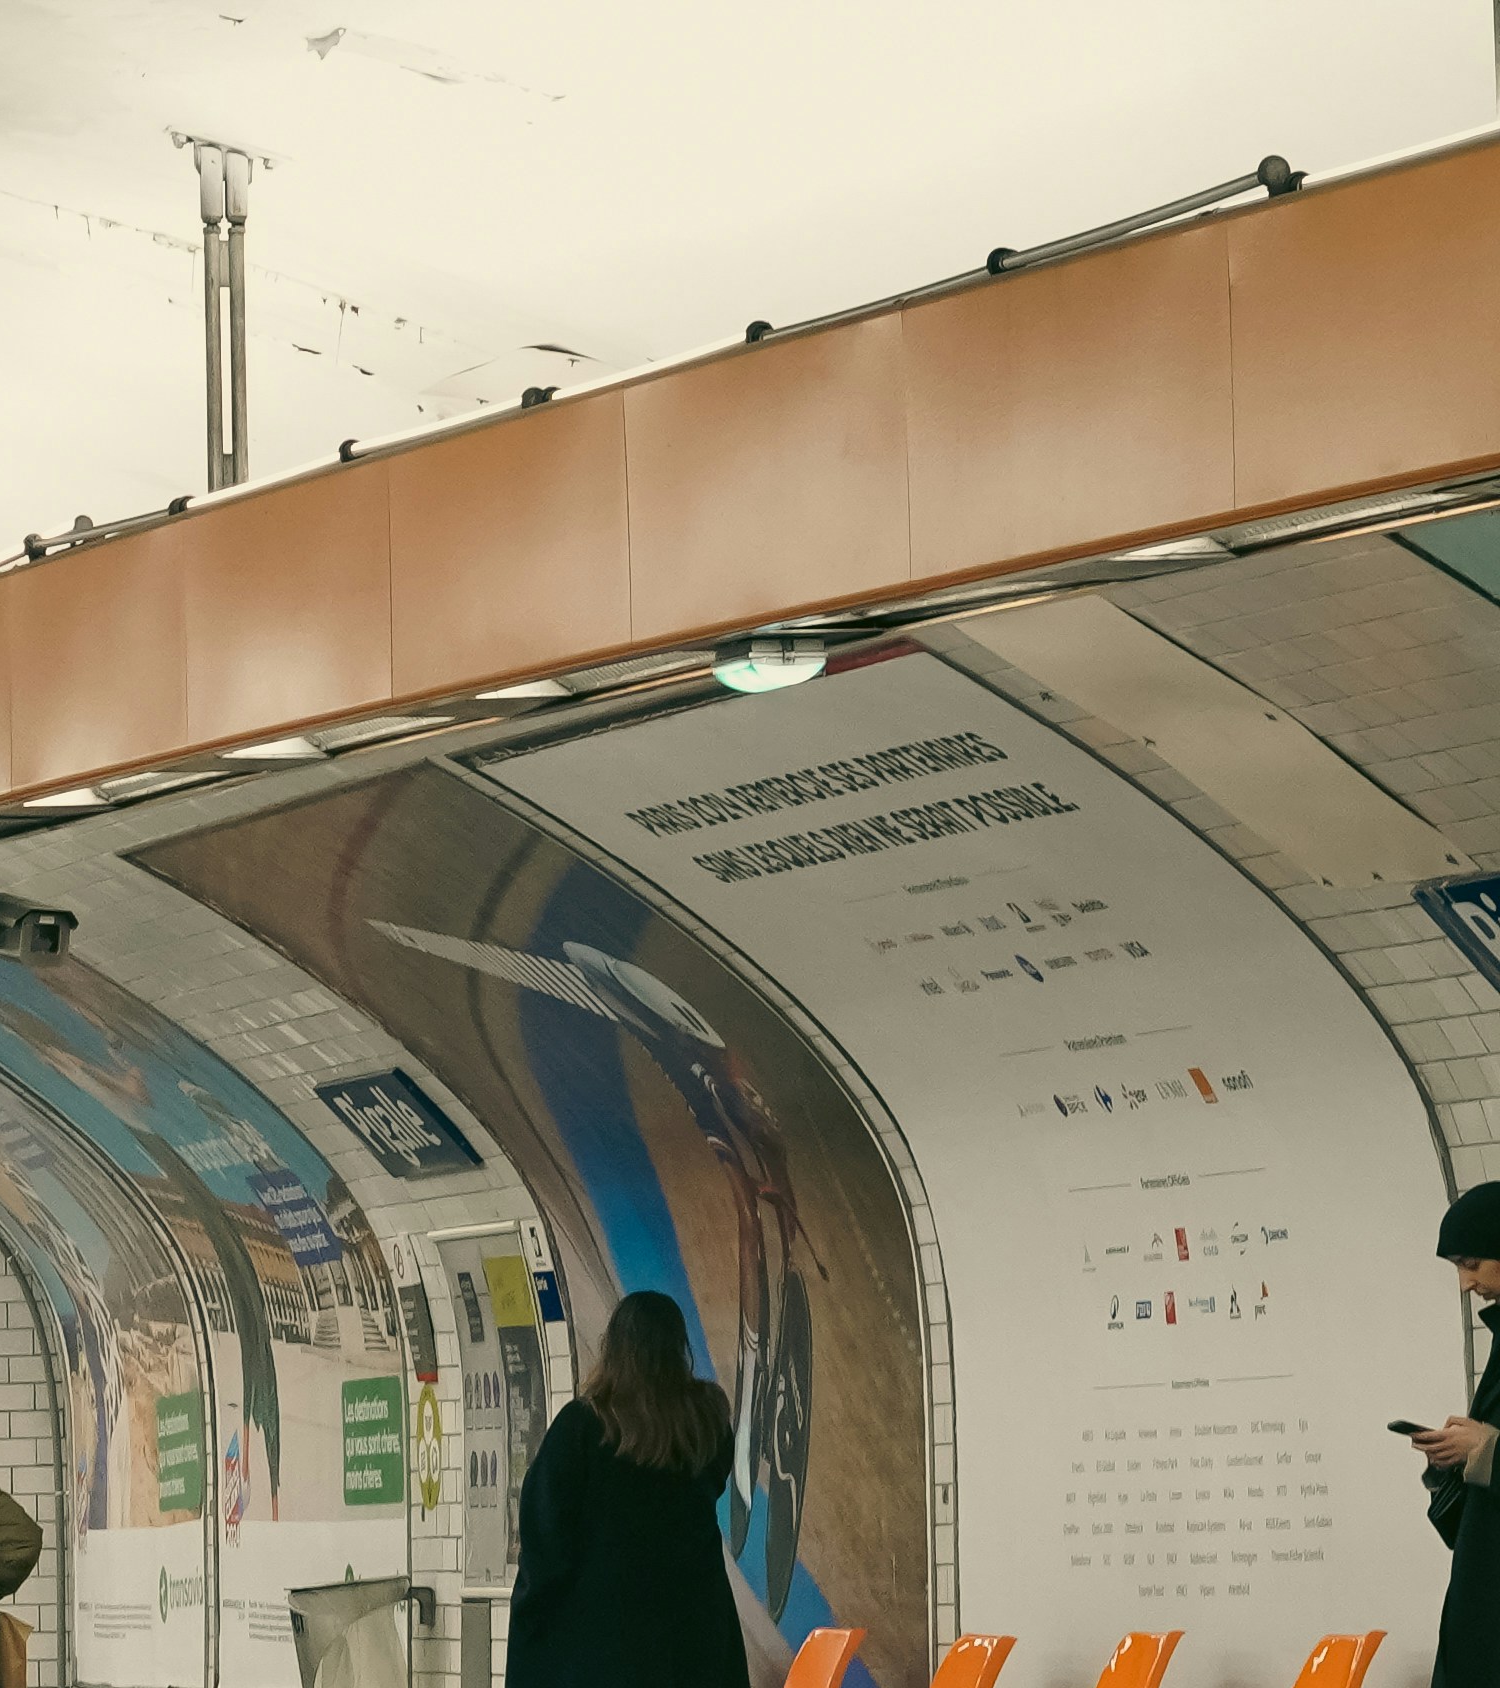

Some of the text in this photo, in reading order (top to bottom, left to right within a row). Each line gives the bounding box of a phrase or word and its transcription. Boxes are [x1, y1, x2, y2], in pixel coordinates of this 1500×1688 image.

[629, 730, 1013, 838] PARIS 2024 REMERCIE SES PARTENAIRES
[689, 848, 764, 885] SANS
[735, 830, 850, 875] LESQUELS
[819, 821, 891, 856] RIEN
[885, 800, 983, 840] SERAIT
[332, 1084, 443, 1169] Pigalle
